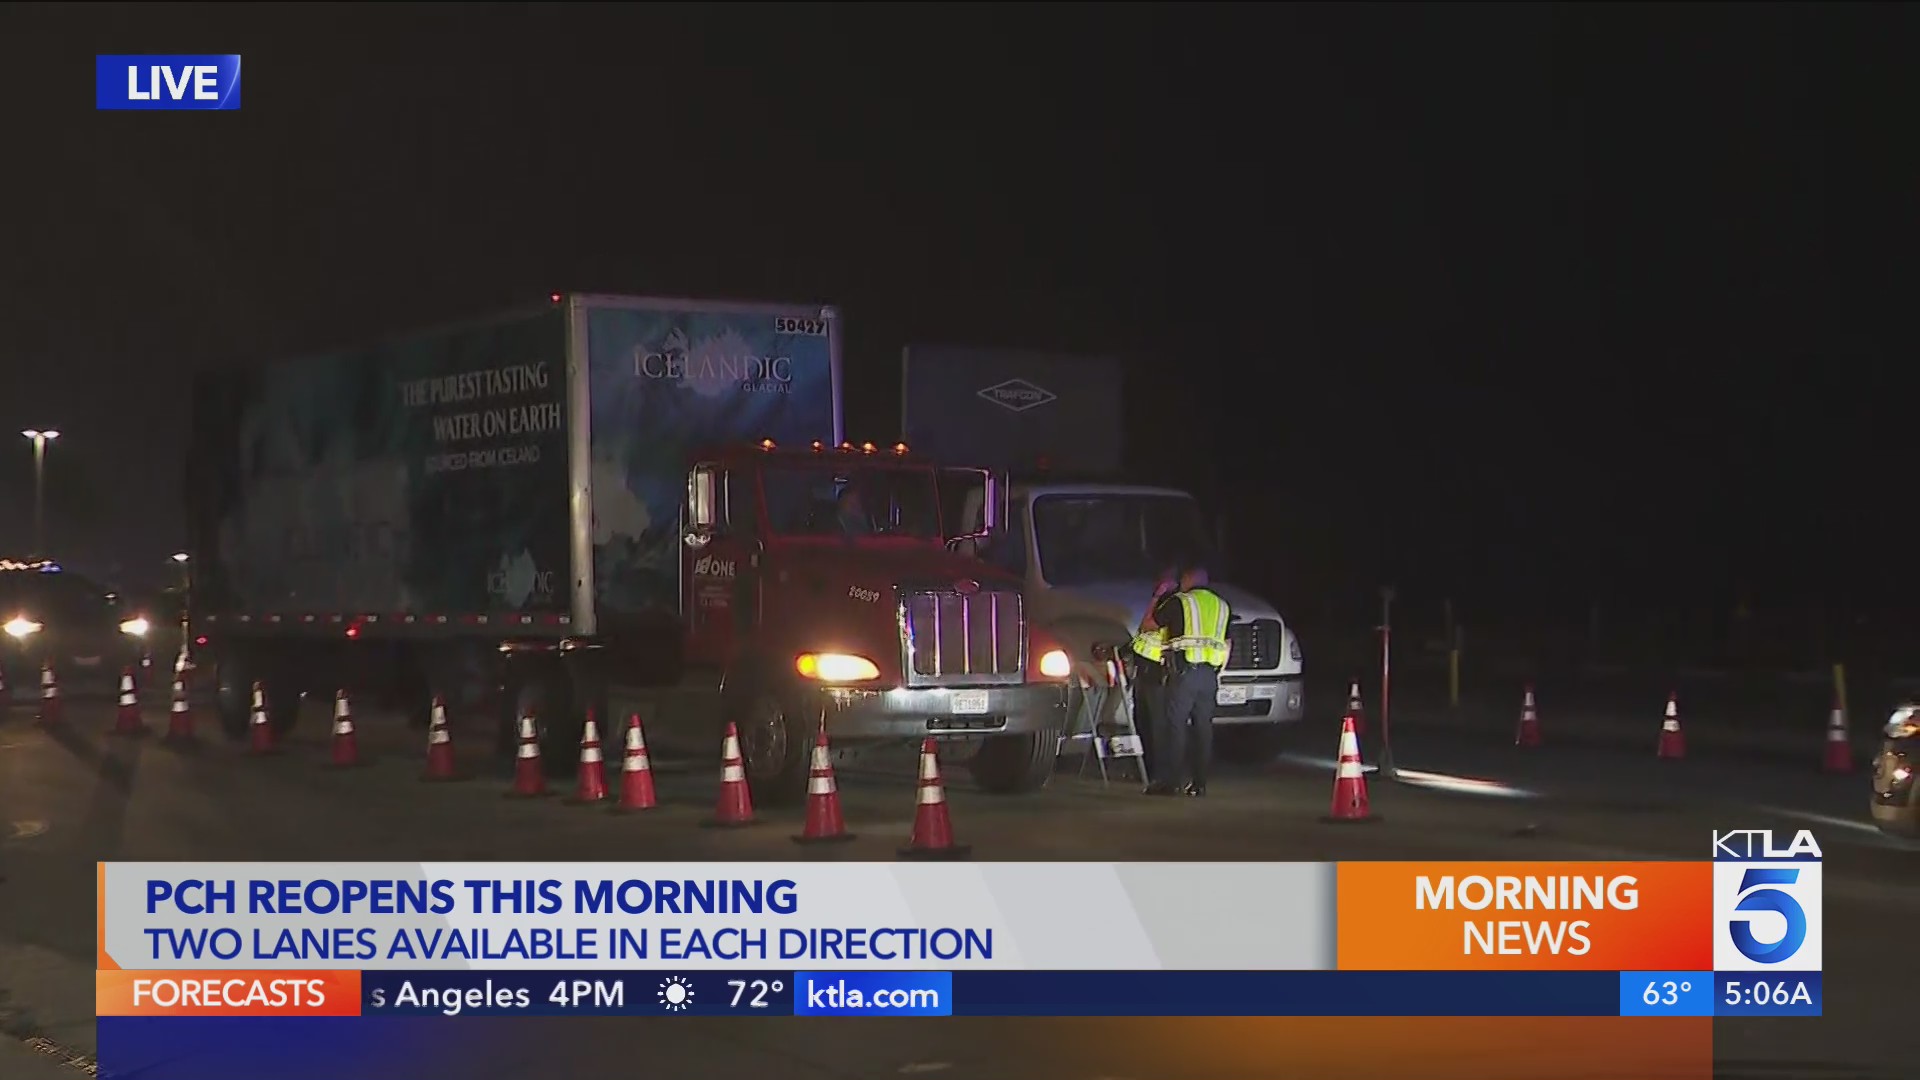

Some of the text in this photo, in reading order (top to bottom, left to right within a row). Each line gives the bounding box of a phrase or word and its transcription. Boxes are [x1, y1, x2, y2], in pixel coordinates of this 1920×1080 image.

[776, 318, 826, 335] 50427
[401, 361, 549, 405] THE PUREST TASTING
[633, 351, 793, 383] ICELANDIC
[741, 381, 793, 395] GLACIAL
[433, 402, 562, 441] WATER ON EARTH
